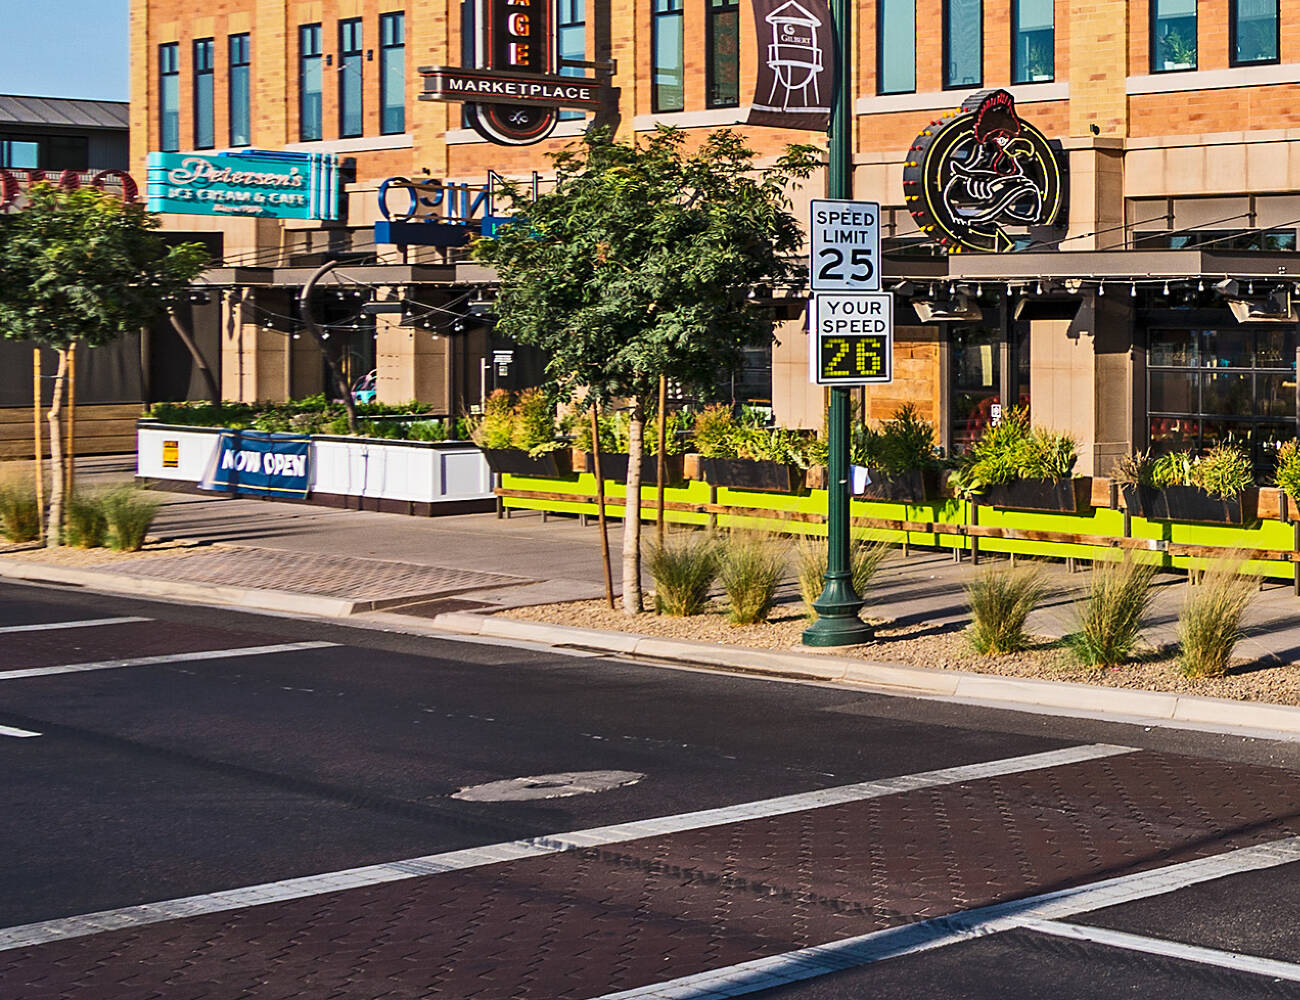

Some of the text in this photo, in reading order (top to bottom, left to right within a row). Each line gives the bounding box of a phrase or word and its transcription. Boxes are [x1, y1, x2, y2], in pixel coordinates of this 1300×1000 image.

[449, 78, 591, 101] MARKETPLACE
[168, 188, 193, 200] ICE
[196, 189, 251, 202] CREAM
[816, 211, 875, 226] SPEED
[823, 229, 869, 245] LIMIT
[818, 247, 874, 282] 25
[827, 301, 882, 316] YOUR
[822, 319, 886, 334] SPEED
[824, 338, 881, 376] 26
[221, 449, 307, 478] NOW OPEN
